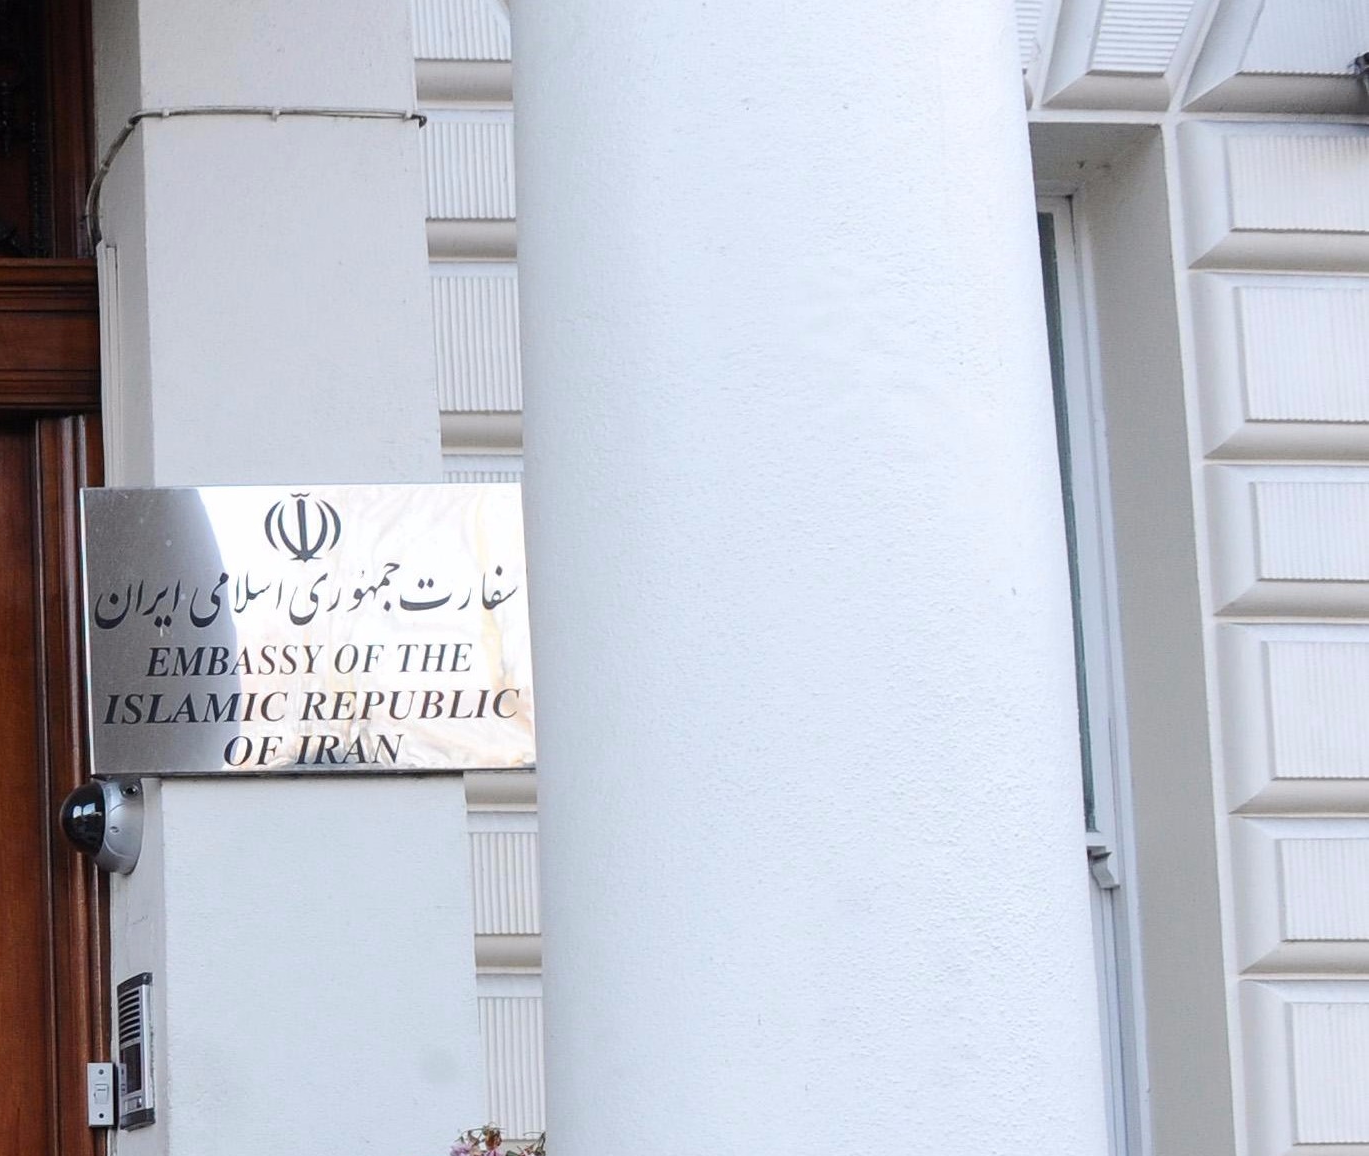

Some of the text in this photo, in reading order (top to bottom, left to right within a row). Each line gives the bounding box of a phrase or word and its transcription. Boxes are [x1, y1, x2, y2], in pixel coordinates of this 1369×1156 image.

[94, 578, 181, 630] ایران
[400, 565, 518, 611] سفارت
[145, 642, 473, 677] EMBASSY OF THE
[102, 688, 521, 725] ISLAMIC REPUBLIC
[223, 733, 405, 767] OF IRAN
